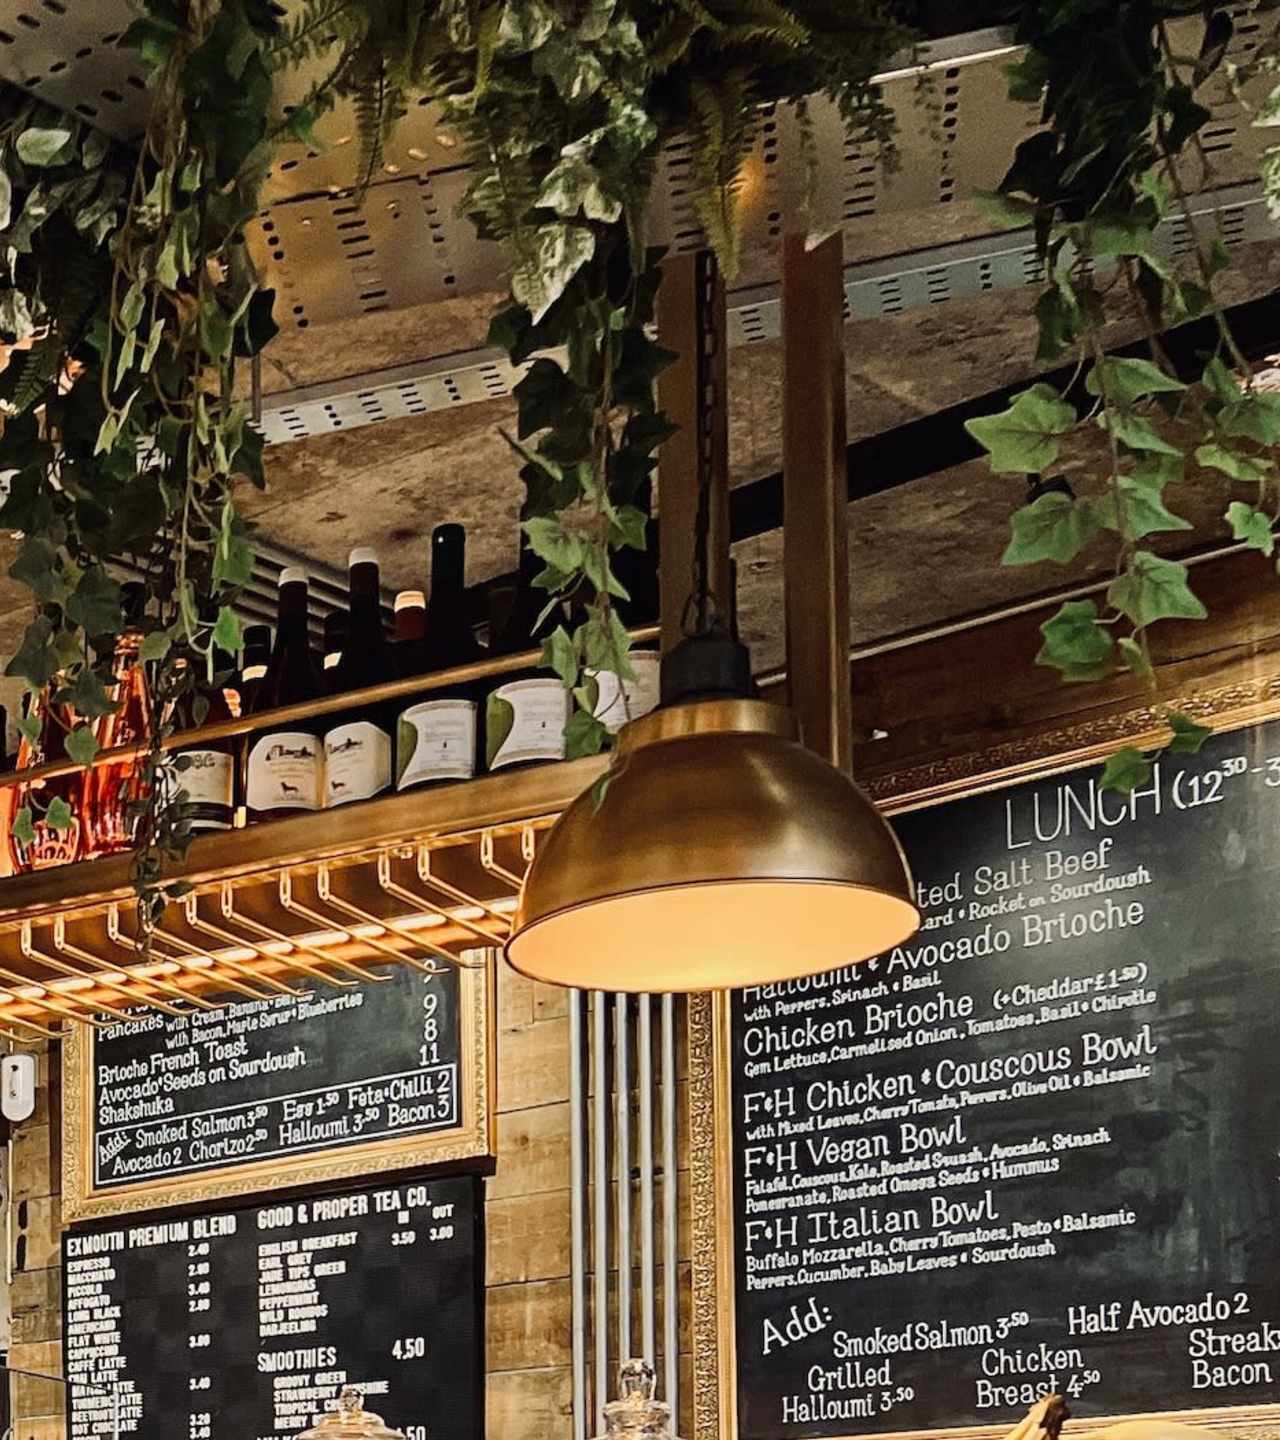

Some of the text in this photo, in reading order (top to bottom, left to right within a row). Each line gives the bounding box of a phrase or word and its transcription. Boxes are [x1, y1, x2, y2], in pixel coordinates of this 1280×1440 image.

[1006, 763, 1160, 850] LUNCH
[974, 838, 1114, 896] Salt Beef
[968, 896, 1026, 921] Rocket
[1050, 865, 1152, 903] Sourdough
[887, 899, 1144, 974] Avocado Brioche
[423, 994, 437, 1019] 9
[745, 971, 942, 1022] with Spinach Basil
[98, 1013, 163, 1041] Pancakes
[744, 992, 974, 1057] Chicken Brioche
[98, 1019, 437, 1085] Brioche French Toast 8
[745, 1062, 771, 1078] Gem
[807, 1073, 916, 1112] Chicken
[936, 1047, 1071, 1090] Couscous
[1081, 1024, 1157, 1066] Bowl
[99, 1043, 440, 1105] Avocado Seeds on Sourdough 11
[99, 1097, 174, 1126] Shakshuka
[136, 1120, 188, 1148] Smoked
[192, 1114, 246, 1138] Salmon
[283, 1100, 313, 1122] Egg
[348, 1087, 385, 1109] Feta
[391, 1075, 434, 1101] Chilli
[437, 1071, 450, 1093] 2
[747, 1124, 775, 1141] with
[778, 1117, 814, 1137] Mixed
[1083, 1064, 1151, 1086] Balsamic
[112, 1152, 171, 1176] Avocado
[172, 1147, 182, 1164] 2
[190, 1138, 246, 1162] Chorizo
[279, 1116, 350, 1146] Halloumi
[388, 1103, 436, 1127] Bacon
[438, 1095, 449, 1118] 3
[807, 1135, 890, 1166] Vegan
[900, 1115, 966, 1154] Bowl
[832, 1157, 1060, 1202] Roasted Omega Seeds Hummus
[881, 1156, 930, 1176] Roasted
[258, 1186, 431, 1229] GOOD & PROPER TEA CO.
[433, 1204, 454, 1219] OUT
[807, 1207, 920, 1243] Italian
[931, 1190, 999, 1228] Bowl
[67, 1215, 236, 1256] EXMOUTH PREMIUM BLEND
[392, 1231, 416, 1245] 3.50
[746, 1253, 798, 1272] Buffalo
[889, 1235, 939, 1254] Cherry
[1013, 1220, 1052, 1238] Pesto
[1063, 1209, 1137, 1233] Balsamic
[870, 1258, 905, 1276] Baby
[907, 1252, 958, 1272] Leaves
[972, 1239, 1056, 1264] Sourdough
[762, 1297, 833, 1355] Add:
[1068, 1292, 1250, 1336] Half Avocado 2
[68, 1331, 121, 1348] FLAT WHITE
[258, 1347, 336, 1372] SMOOTHIES
[833, 1324, 912, 1359] Smoked
[915, 1320, 994, 1351] Salmon
[982, 1343, 1084, 1377] Chicken
[98, 1356, 126, 1370] LATTE
[807, 1359, 893, 1391] Grilled
[1192, 1360, 1272, 1389] Bacon
[782, 1387, 915, 1423] Halloumi 3.50
[976, 1374, 1060, 1409] Breast
